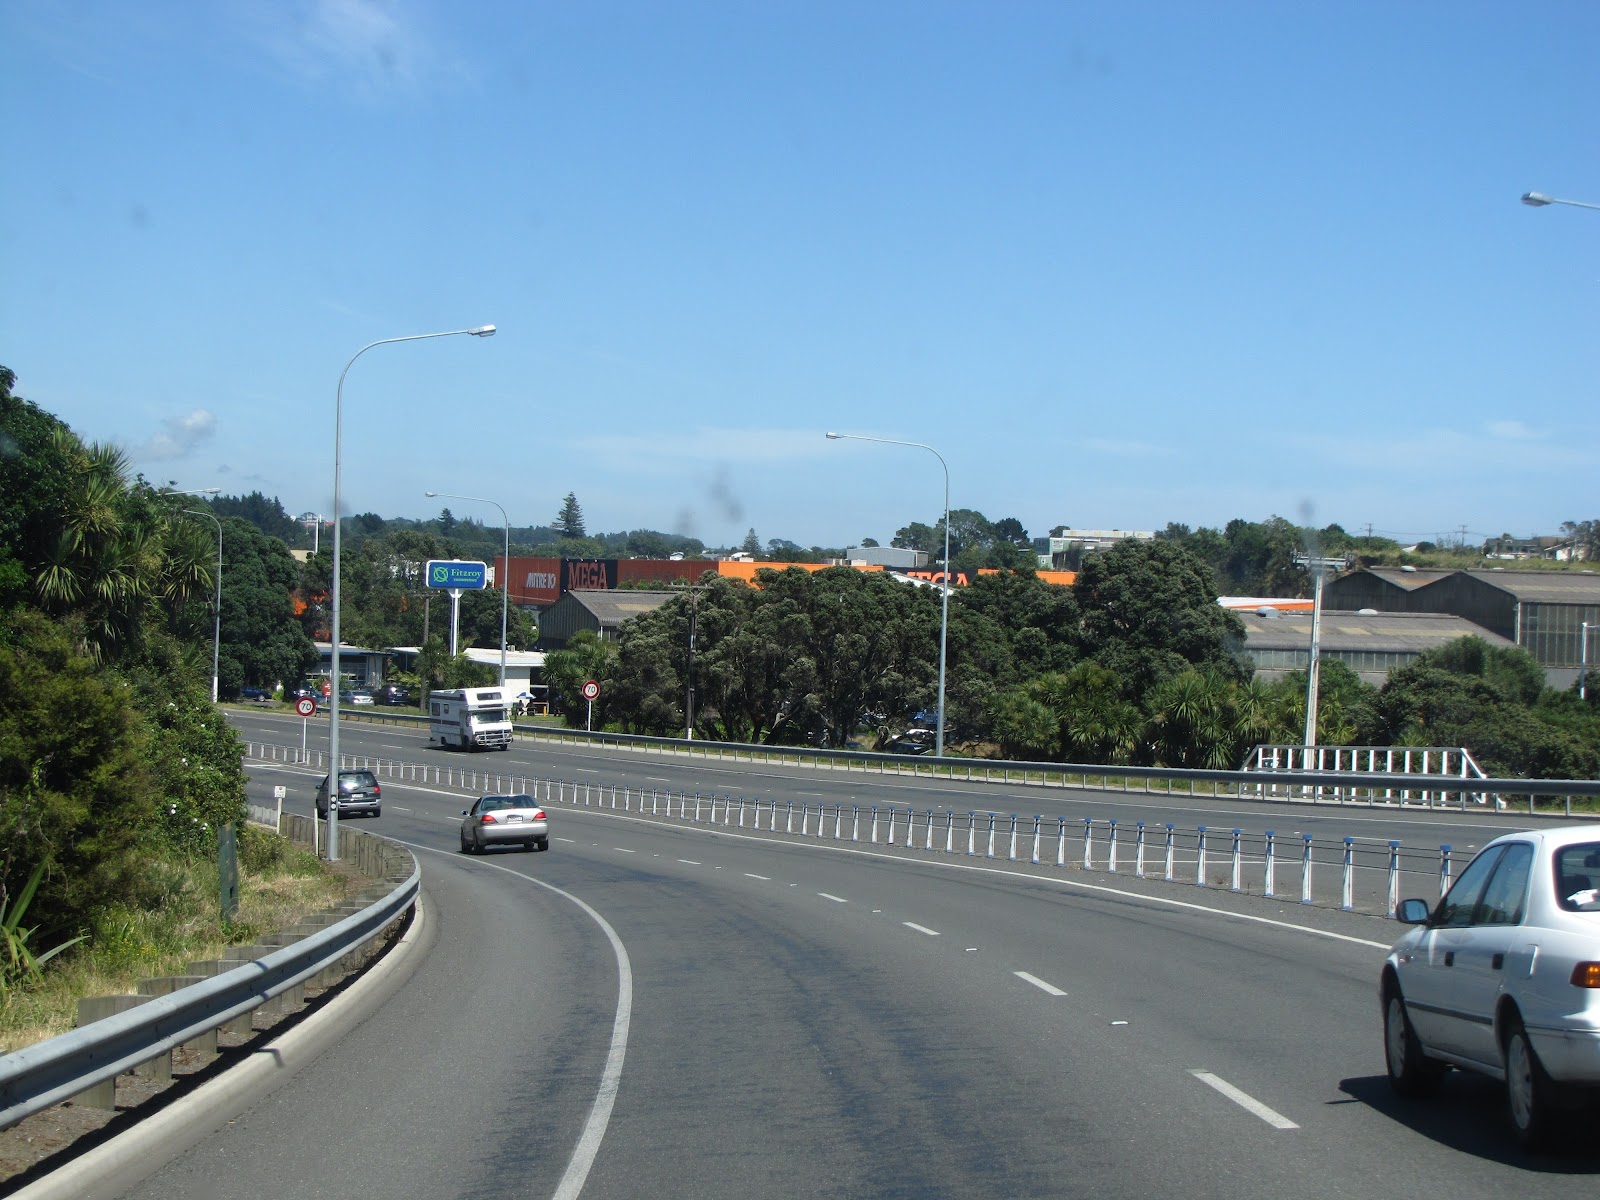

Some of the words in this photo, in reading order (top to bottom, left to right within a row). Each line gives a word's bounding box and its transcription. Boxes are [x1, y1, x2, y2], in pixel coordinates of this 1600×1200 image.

[451, 569, 482, 579] Fitzroy
[526, 572, 547, 589] MITRE
[547, 573, 556, 589] 10
[568, 562, 608, 589] MEGA
[906, 571, 969, 587] EGA
[301, 703, 311, 711] 70
